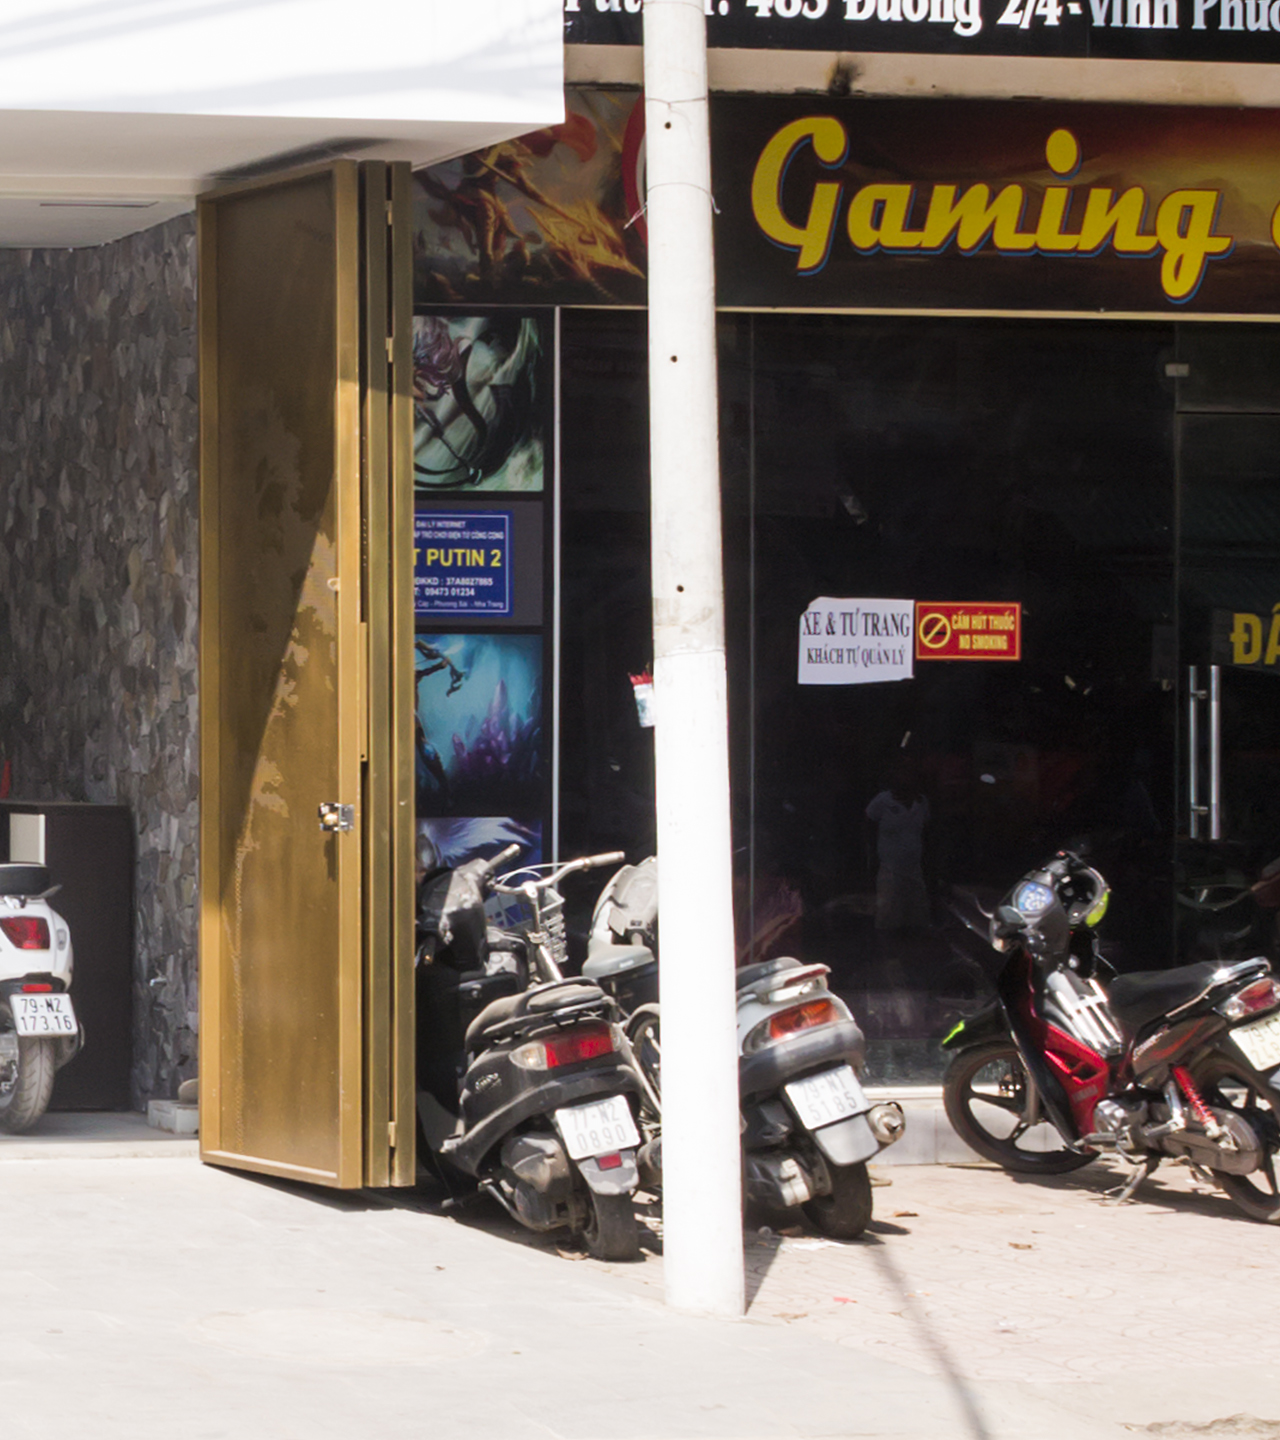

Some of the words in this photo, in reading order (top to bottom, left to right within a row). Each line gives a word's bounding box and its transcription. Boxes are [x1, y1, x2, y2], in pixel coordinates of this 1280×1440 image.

[751, 116, 1233, 299] Gaming
[426, 548, 485, 567] PUTIN
[490, 548, 501, 567] 2
[803, 611, 821, 636] XE
[825, 611, 837, 636] &
[862, 611, 910, 638] TRANG
[806, 644, 844, 664] KHÁCH
[20, 997, 64, 1014] 79-N2
[20, 1014, 74, 1032] 173.16
[808, 1091, 858, 1121] 5185
[576, 1123, 628, 1152] 0890
